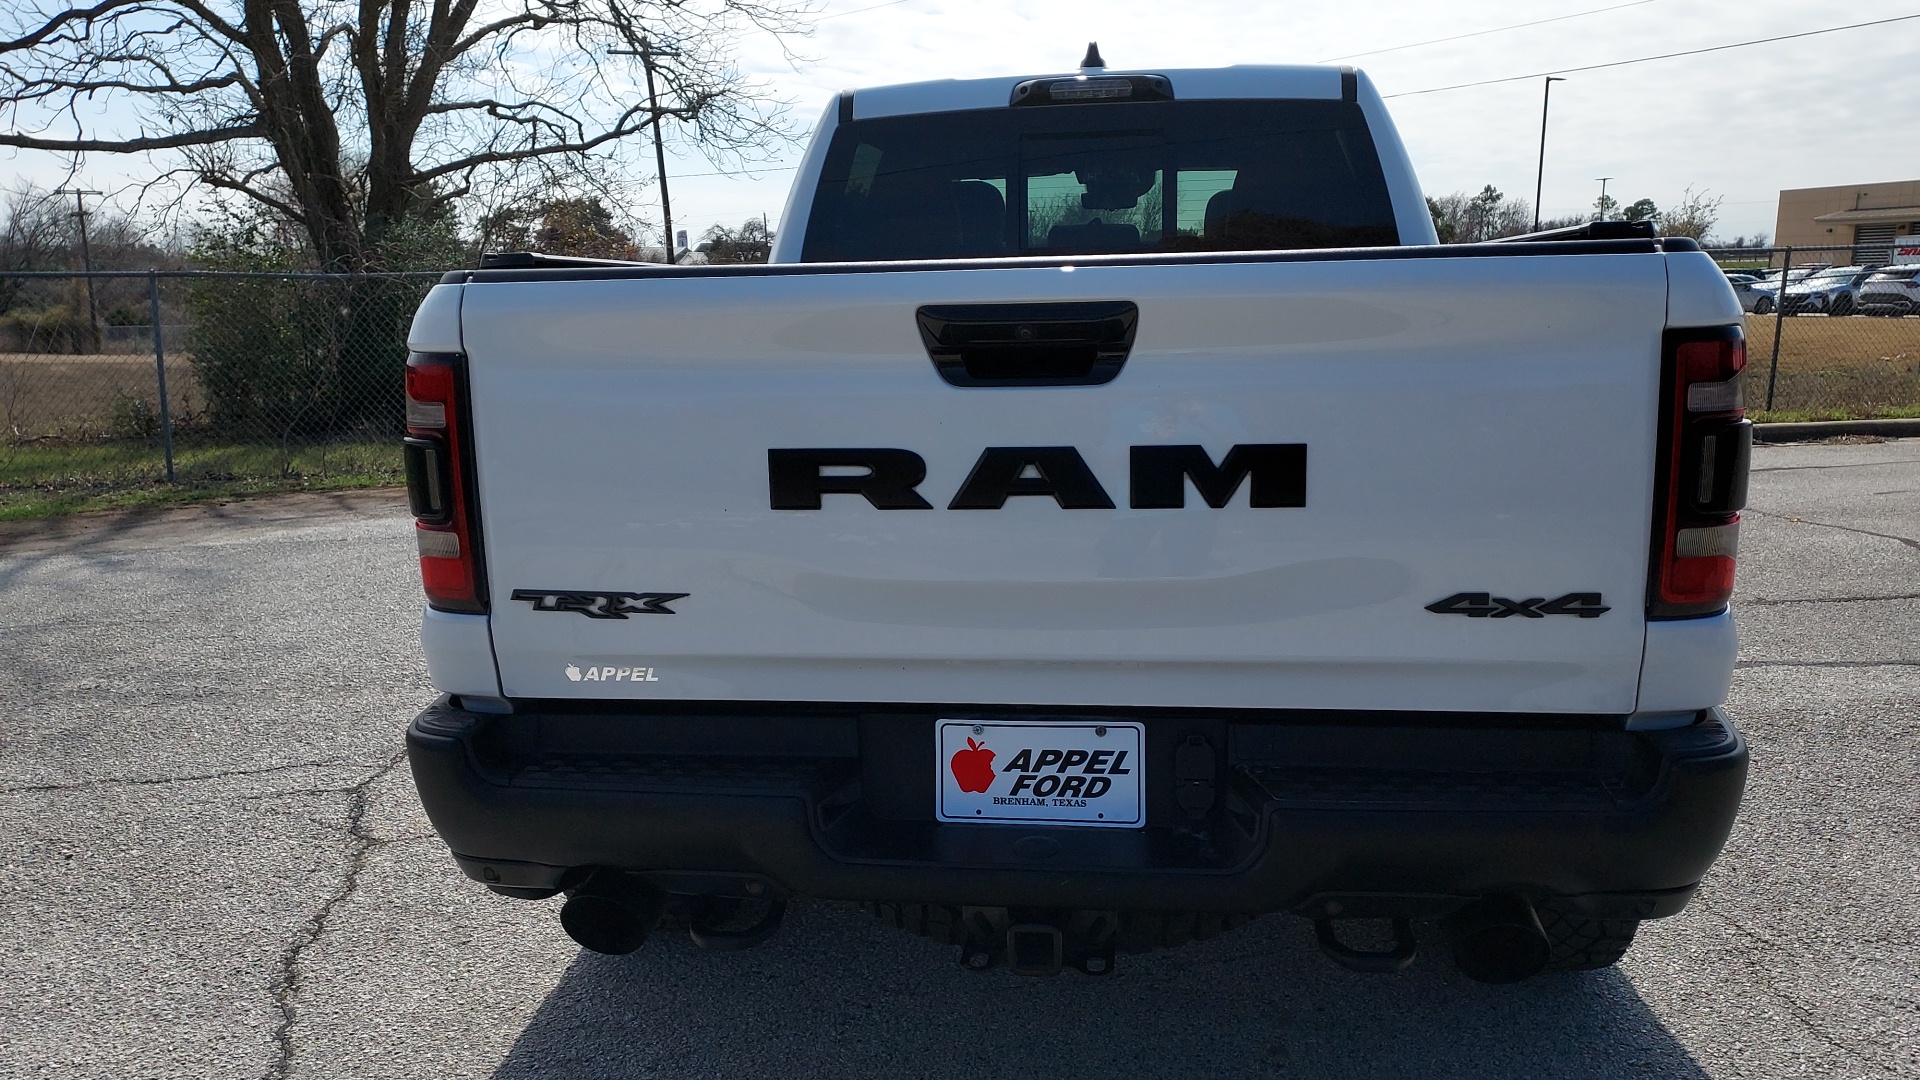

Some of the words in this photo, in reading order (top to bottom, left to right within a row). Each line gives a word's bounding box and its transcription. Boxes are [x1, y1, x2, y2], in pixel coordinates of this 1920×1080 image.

[767, 443, 1308, 510] RAM
[510, 588, 691, 620] TRX
[1424, 592, 1612, 618] 4x4
[582, 666, 659, 682] APPEL
[1002, 748, 1132, 775] APPEL
[1008, 775, 1112, 799] FORD
[992, 796, 1049, 807] BRENHAM,
[1052, 798, 1087, 808] TEXAS
